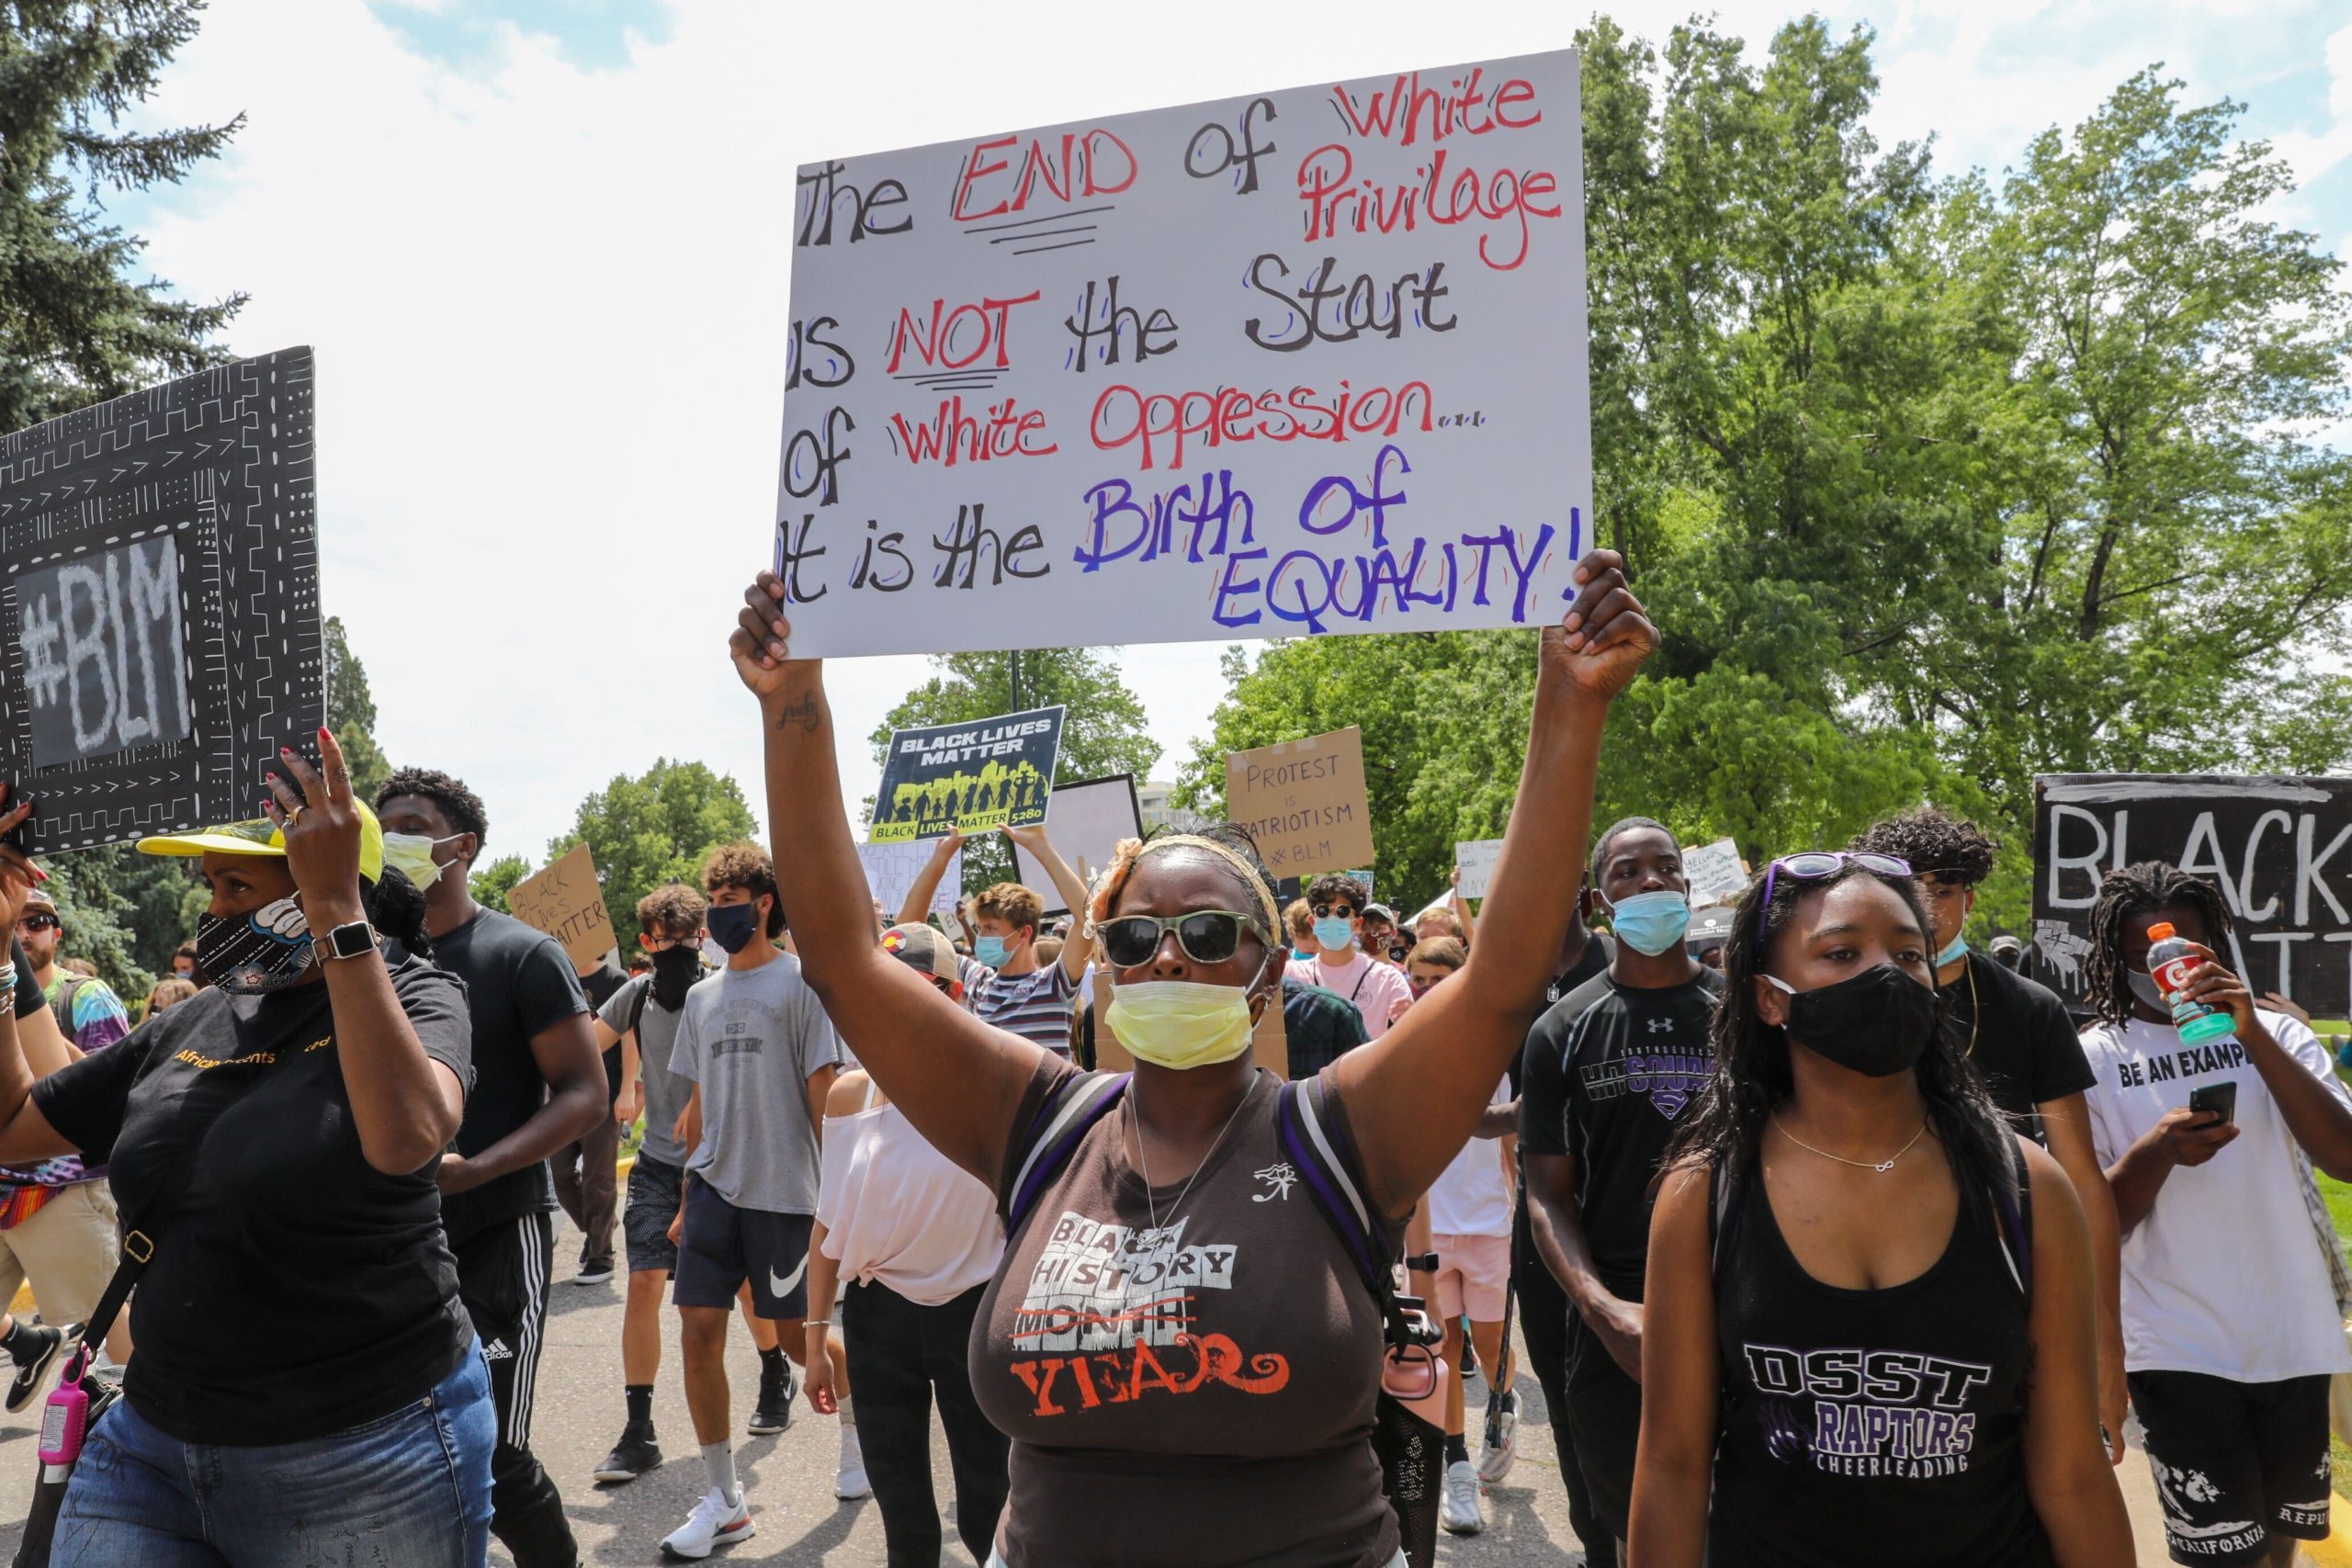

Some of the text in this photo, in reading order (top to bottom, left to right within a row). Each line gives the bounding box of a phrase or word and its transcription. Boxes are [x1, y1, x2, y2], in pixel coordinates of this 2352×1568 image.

[797, 160, 914, 247] The
[951, 129, 1139, 221] END
[1330, 66, 1543, 147] White
[1297, 142, 1563, 271] Privilage
[887, 289, 1041, 374] NOT
[1065, 275, 1180, 373] the
[1243, 253, 1458, 352] Start
[888, 395, 1058, 467] White
[851, 518, 914, 592] is
[933, 502, 1051, 590] the
[1073, 468, 1255, 573] Birth
[1211, 507, 1580, 634] EQUALITY!
[20, 535, 190, 752] #BLM
[899, 718, 1052, 754] BLACK LIVES
[921, 739, 1023, 767] MATTER
[1246, 753, 1340, 793] PROTEST
[876, 824, 915, 839] BLACK
[958, 812, 1007, 829] MATTER
[1011, 808, 1043, 824] 5280
[1240, 803, 1352, 840] PATRIOTISM
[514, 866, 570, 920] BLACK
[550, 900, 608, 947] ATTER
[175, 1049, 220, 1069] African
[2118, 1063, 2145, 1089] BE
[2149, 1055, 2179, 1084] AN
[1033, 1251, 1233, 1291] HISTORY
[1016, 1301, 1185, 1337] MONTH
[485, 1350, 514, 1360] didas
[1011, 1333, 1291, 1417] YEAR
[1744, 1342, 1992, 1408] DSST
[1815, 1399, 1976, 1461] RAPTORS
[1816, 1452, 1969, 1479] CHEERLEADING
[2178, 1524, 2267, 1555] CALIFORNIA
